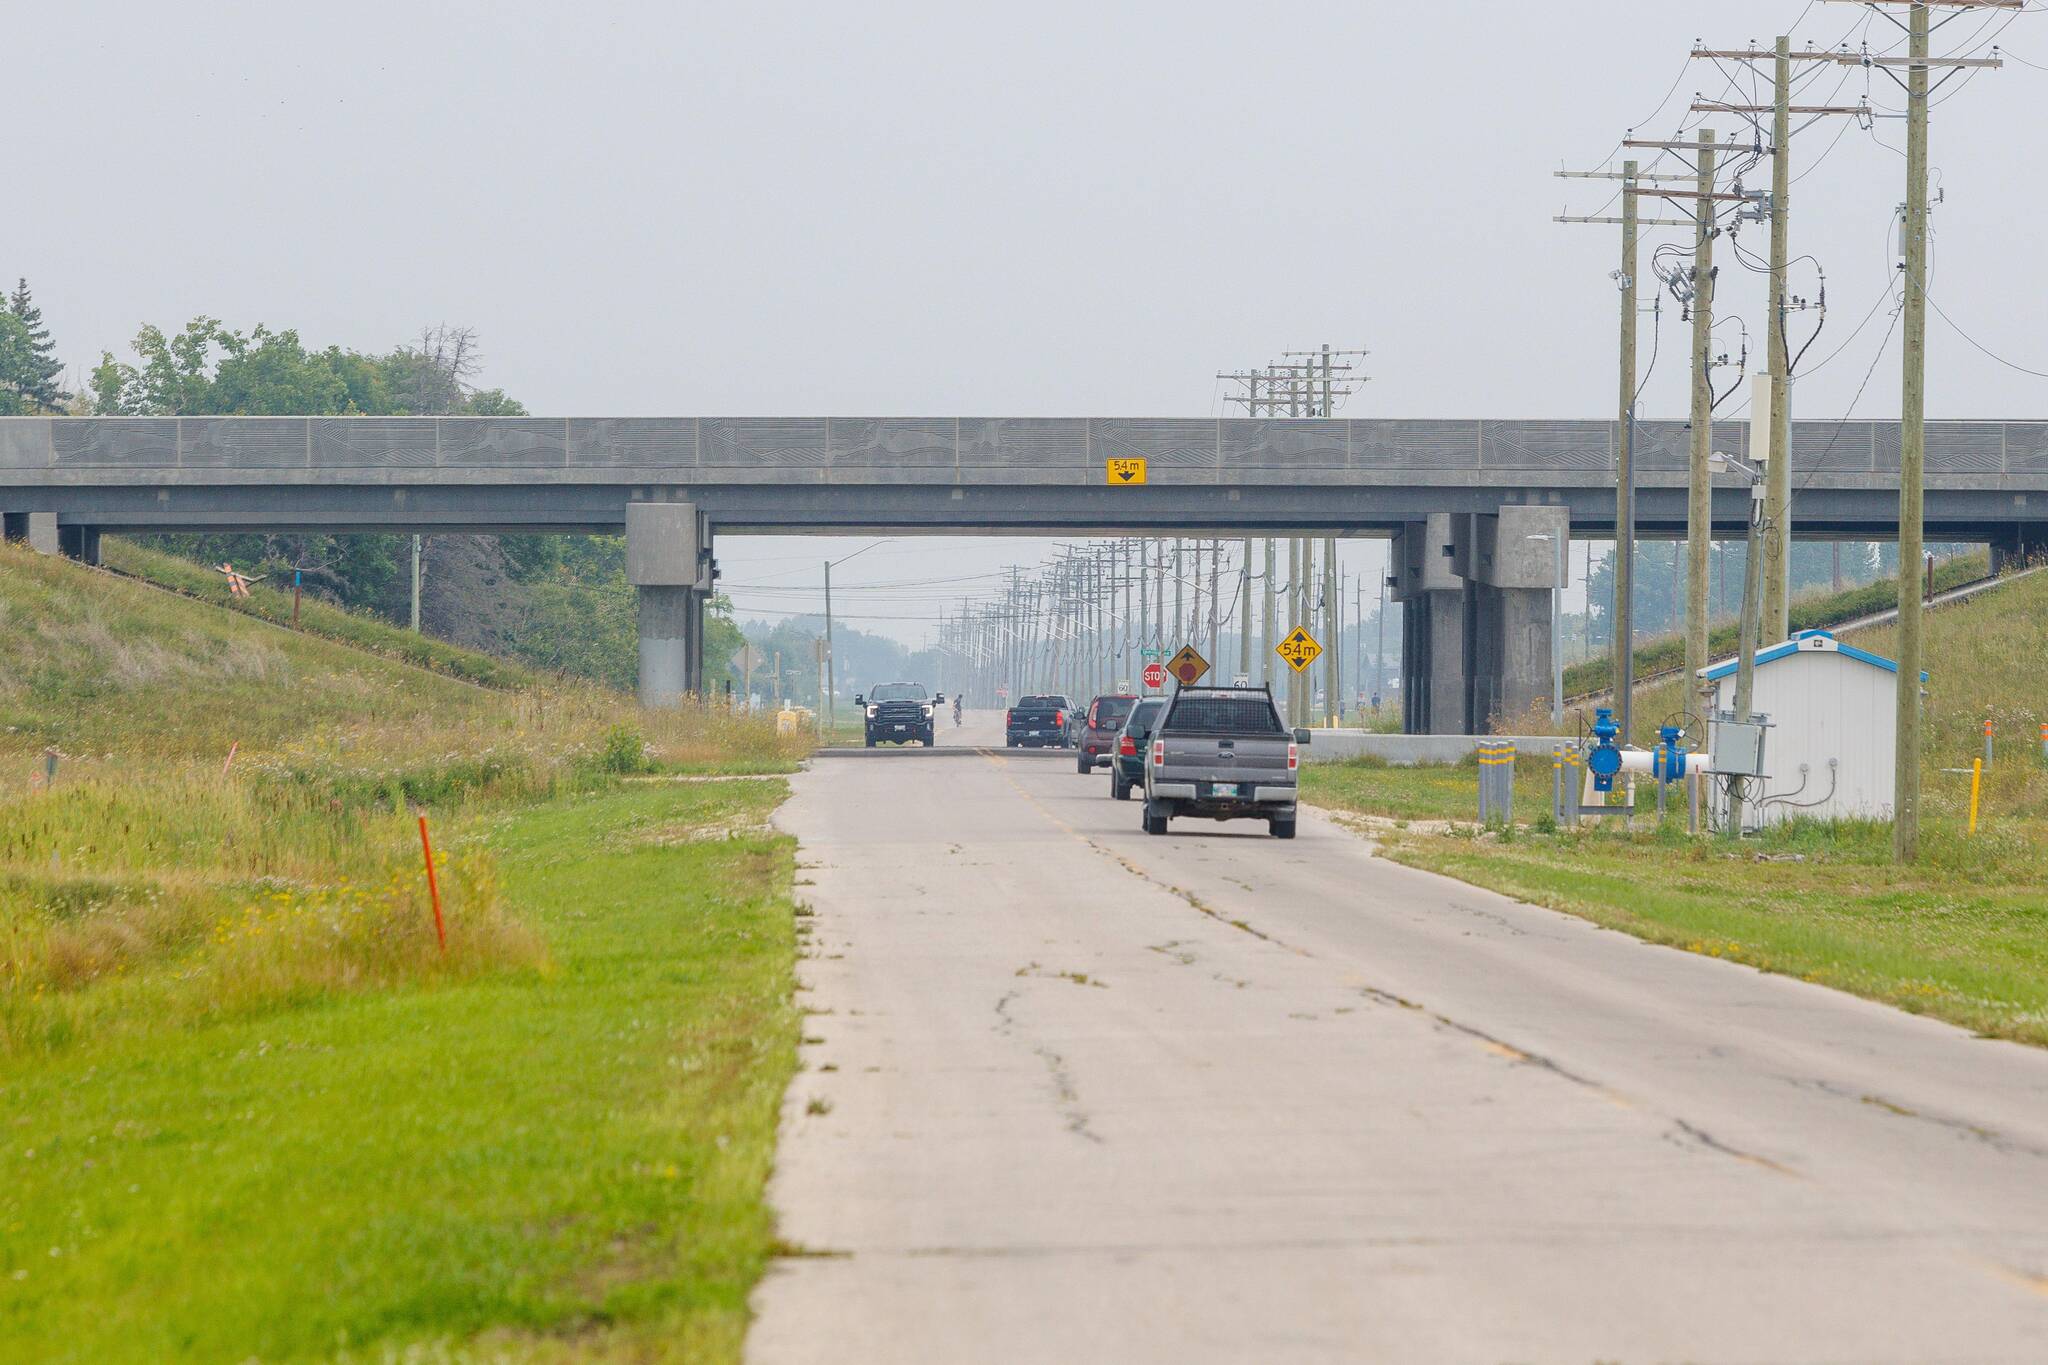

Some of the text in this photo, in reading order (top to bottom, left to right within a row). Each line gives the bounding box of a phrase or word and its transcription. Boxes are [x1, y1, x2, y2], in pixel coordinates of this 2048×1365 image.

[1114, 461, 1139, 470] 5.4 m
[1283, 643, 1316, 656] 5.4 m
